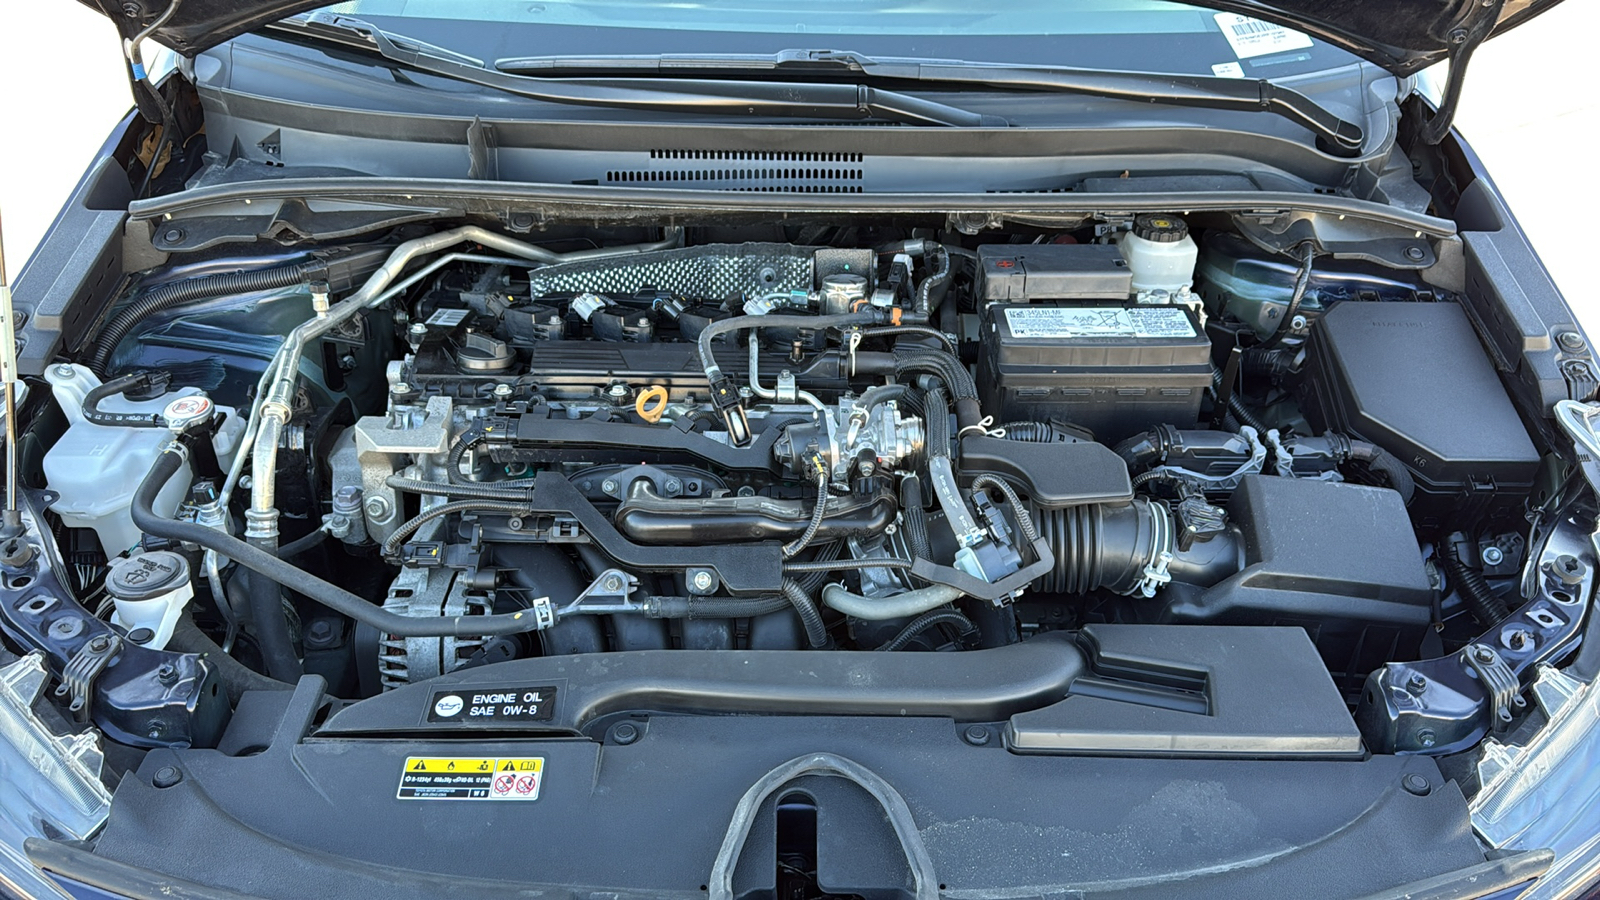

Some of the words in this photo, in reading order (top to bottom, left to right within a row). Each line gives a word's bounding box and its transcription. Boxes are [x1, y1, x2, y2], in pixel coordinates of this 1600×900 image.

[1413, 455, 1427, 468] K6
[472, 693, 516, 704] ENGINE
[522, 692, 543, 703] OIL
[469, 706, 495, 717] SAE
[502, 704, 538, 716] 0W-8
